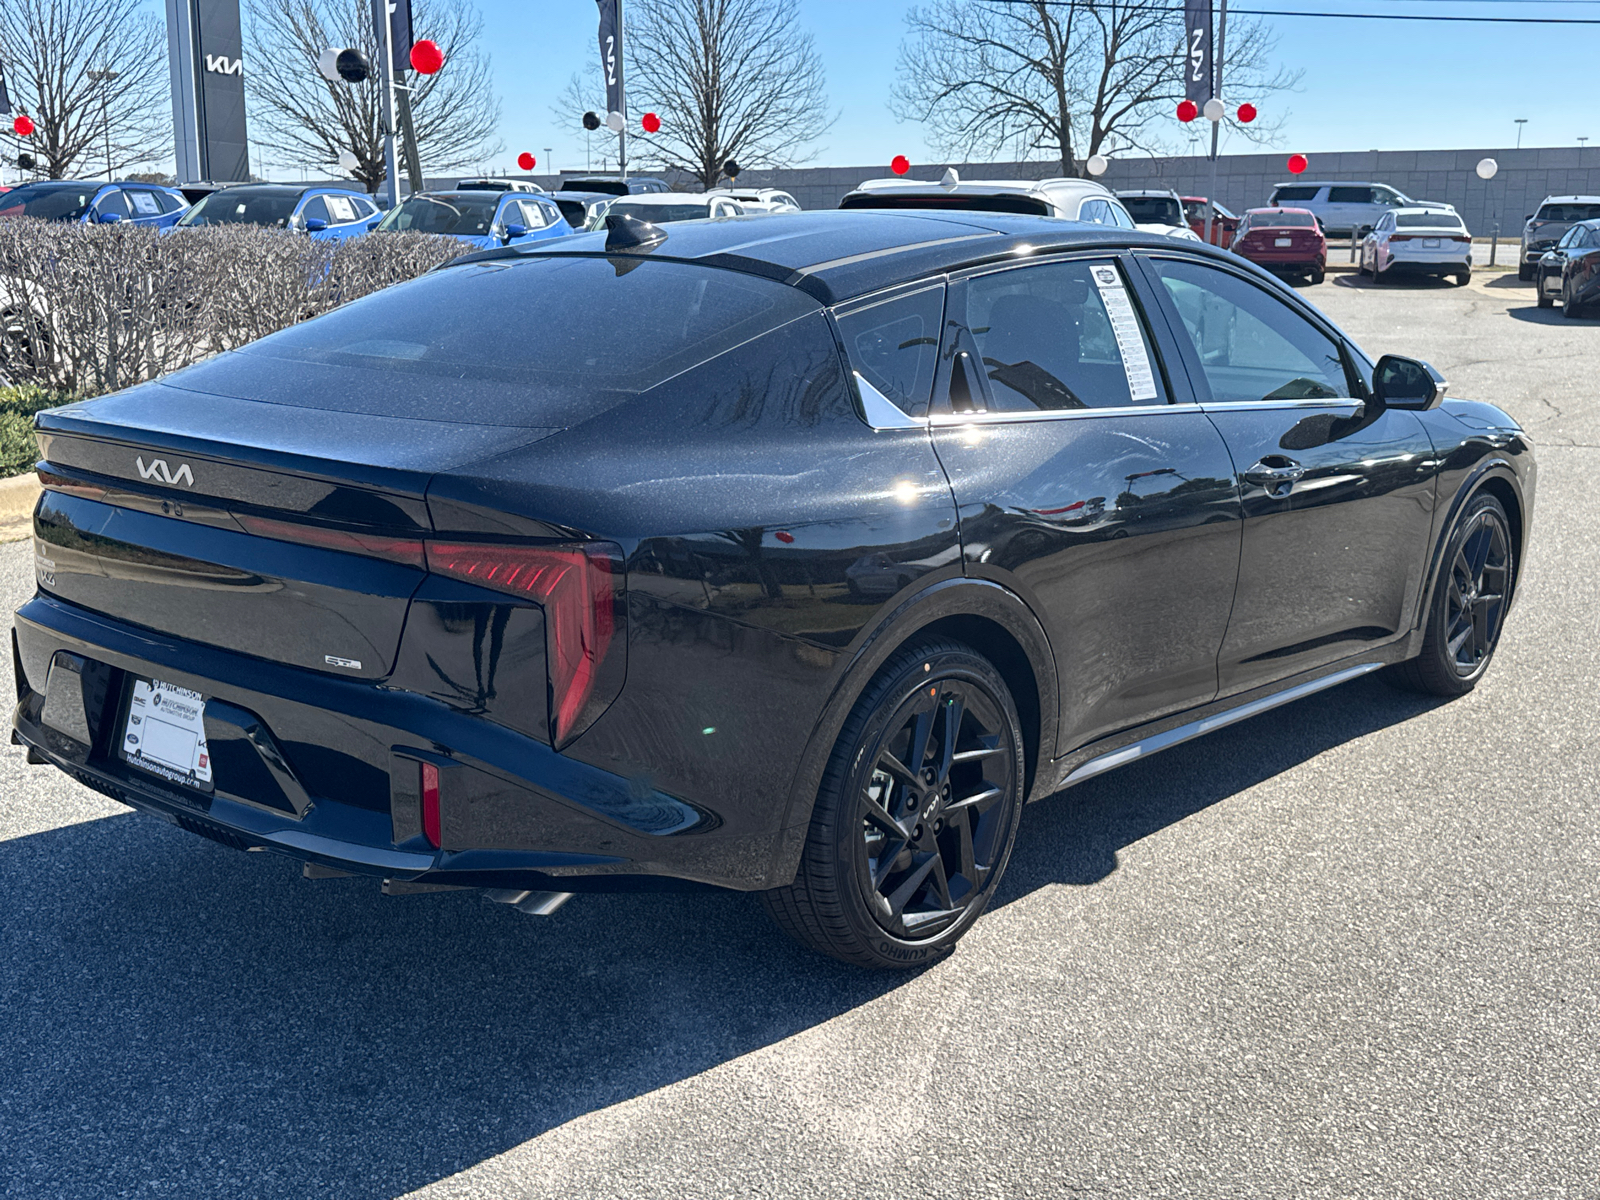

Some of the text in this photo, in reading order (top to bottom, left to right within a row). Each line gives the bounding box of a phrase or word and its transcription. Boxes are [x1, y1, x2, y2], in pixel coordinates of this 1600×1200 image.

[205, 53, 243, 77] KIA
[136, 455, 194, 487] KIA
[879, 941, 928, 961] KUMHO
